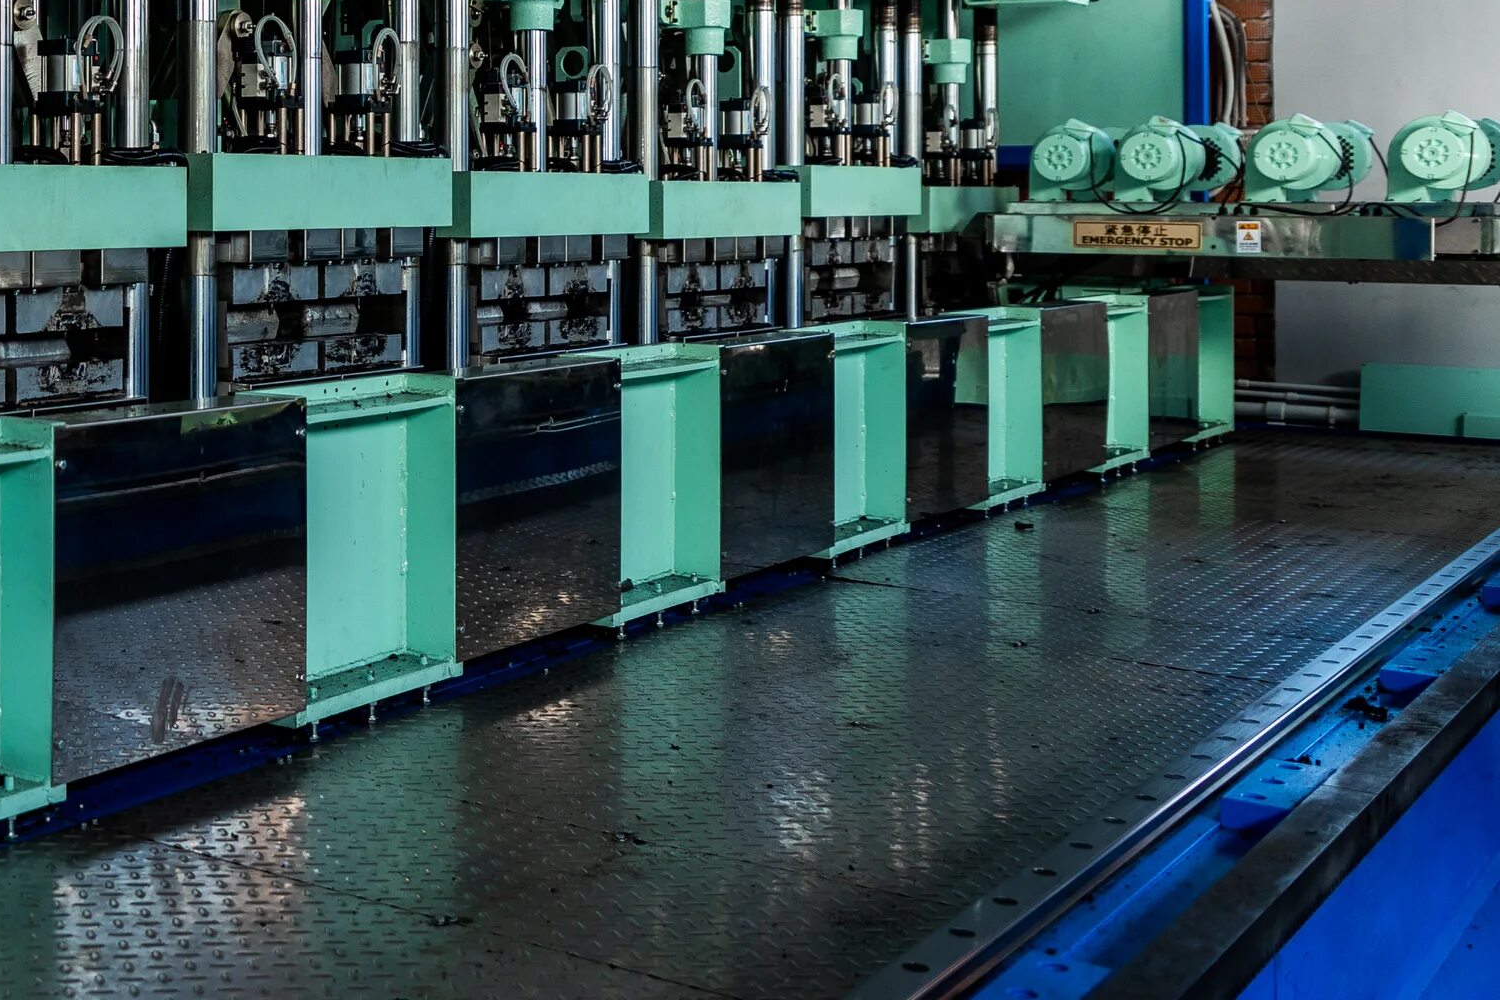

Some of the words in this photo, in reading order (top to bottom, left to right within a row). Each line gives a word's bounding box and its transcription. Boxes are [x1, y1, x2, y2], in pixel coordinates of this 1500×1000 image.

[1105, 224, 1168, 236] 緊急停止
[1082, 235, 1156, 246] EMERGENCY
[1159, 237, 1193, 247] STOP
